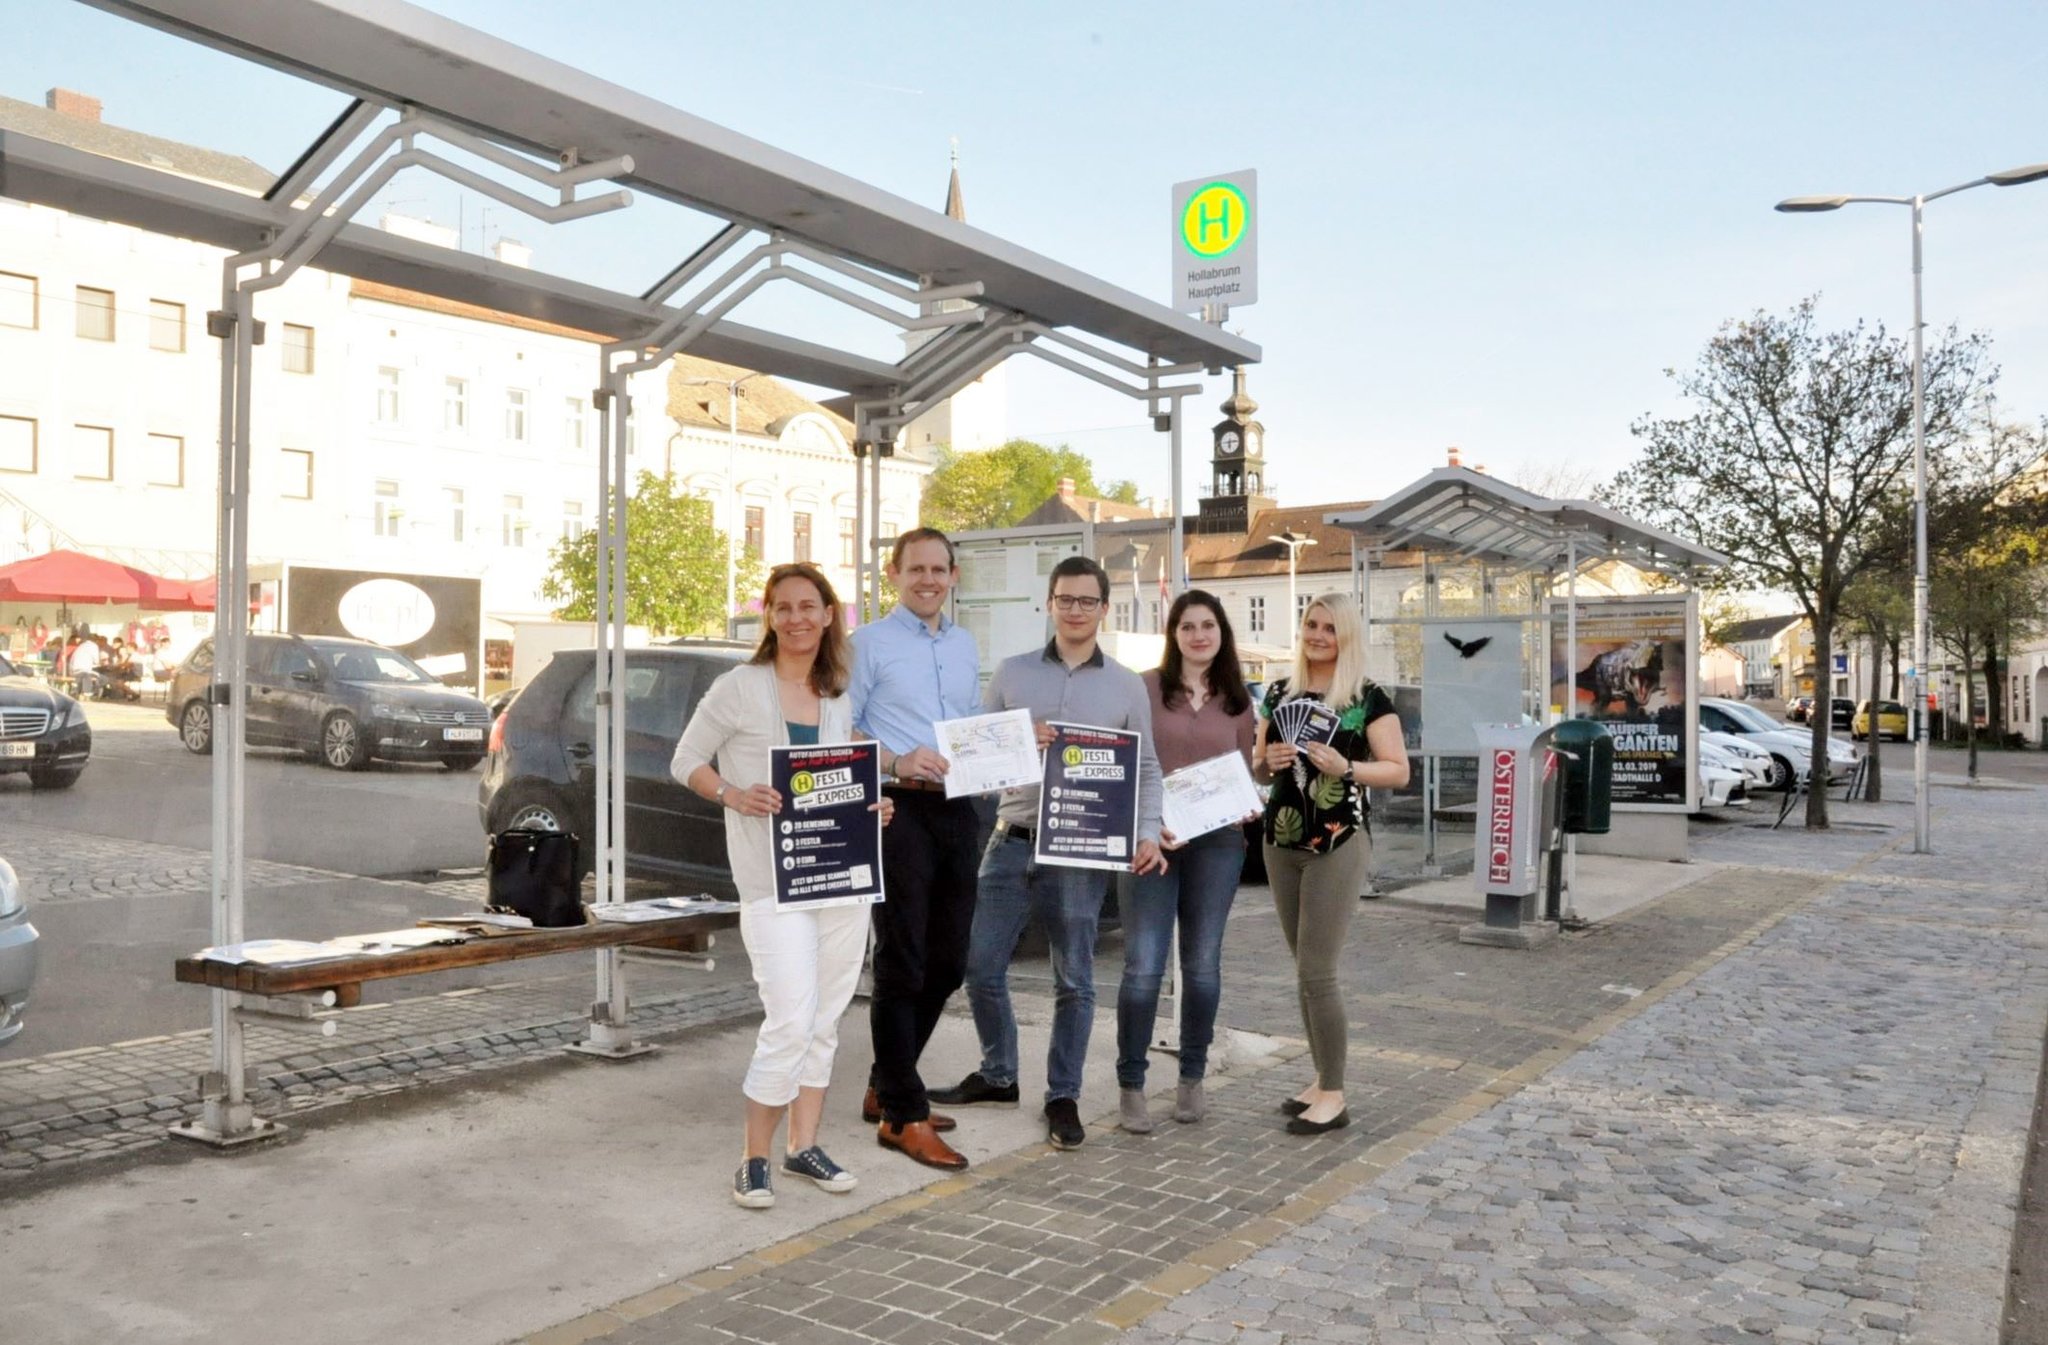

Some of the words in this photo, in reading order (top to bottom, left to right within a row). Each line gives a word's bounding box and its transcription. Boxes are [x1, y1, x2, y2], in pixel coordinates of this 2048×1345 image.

[1199, 197, 1229, 243] H
[1187, 265, 1241, 282] Hollabrunn
[1187, 283, 1241, 299] Hauptplatz
[1613, 734, 1678, 751] GANTEN
[1084, 751, 1111, 762] FESTL
[815, 771, 848, 787] FESTL
[1084, 766, 1124, 778] EXPRESS
[817, 786, 863, 804] EXPRESS
[1491, 750, 1514, 881] ÖSTERREICH
